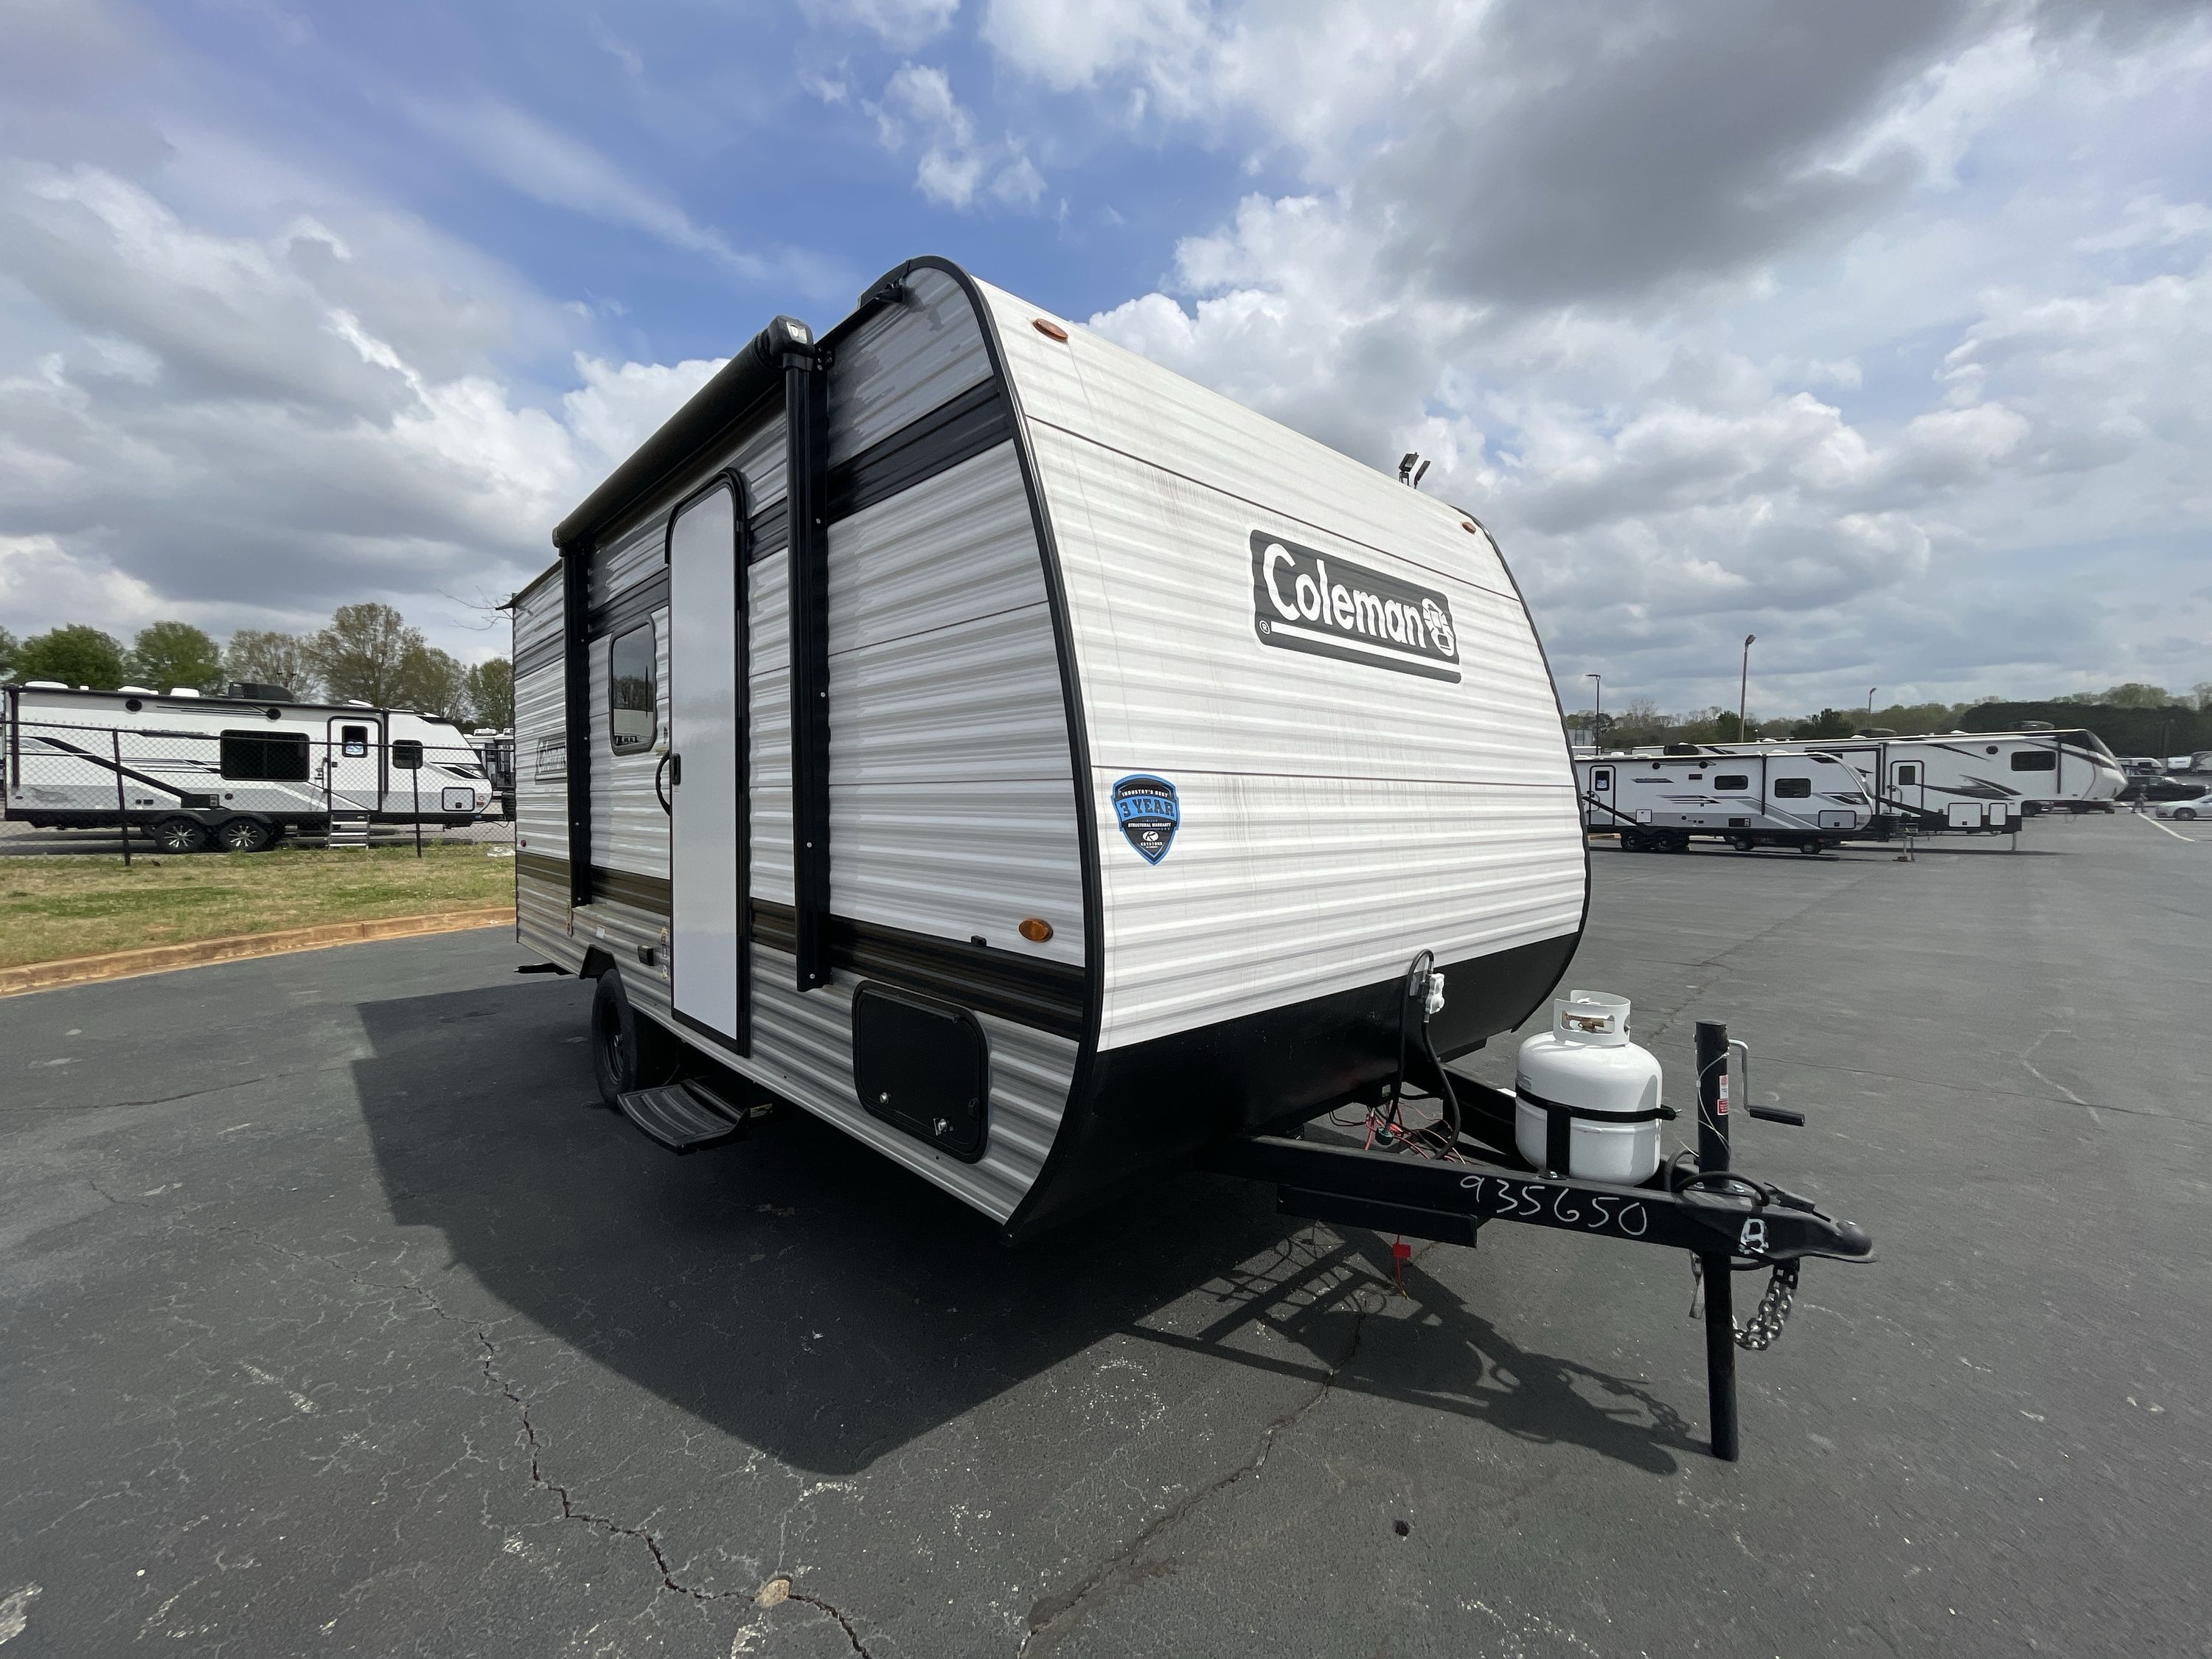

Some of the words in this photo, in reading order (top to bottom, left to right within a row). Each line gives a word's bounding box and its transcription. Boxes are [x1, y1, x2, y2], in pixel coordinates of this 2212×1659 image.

[1263, 543, 1426, 648] Coleman
[1120, 801, 1131, 817] 3
[1132, 799, 1175, 817] YEAR
[1460, 1175, 1647, 1236] 935650
